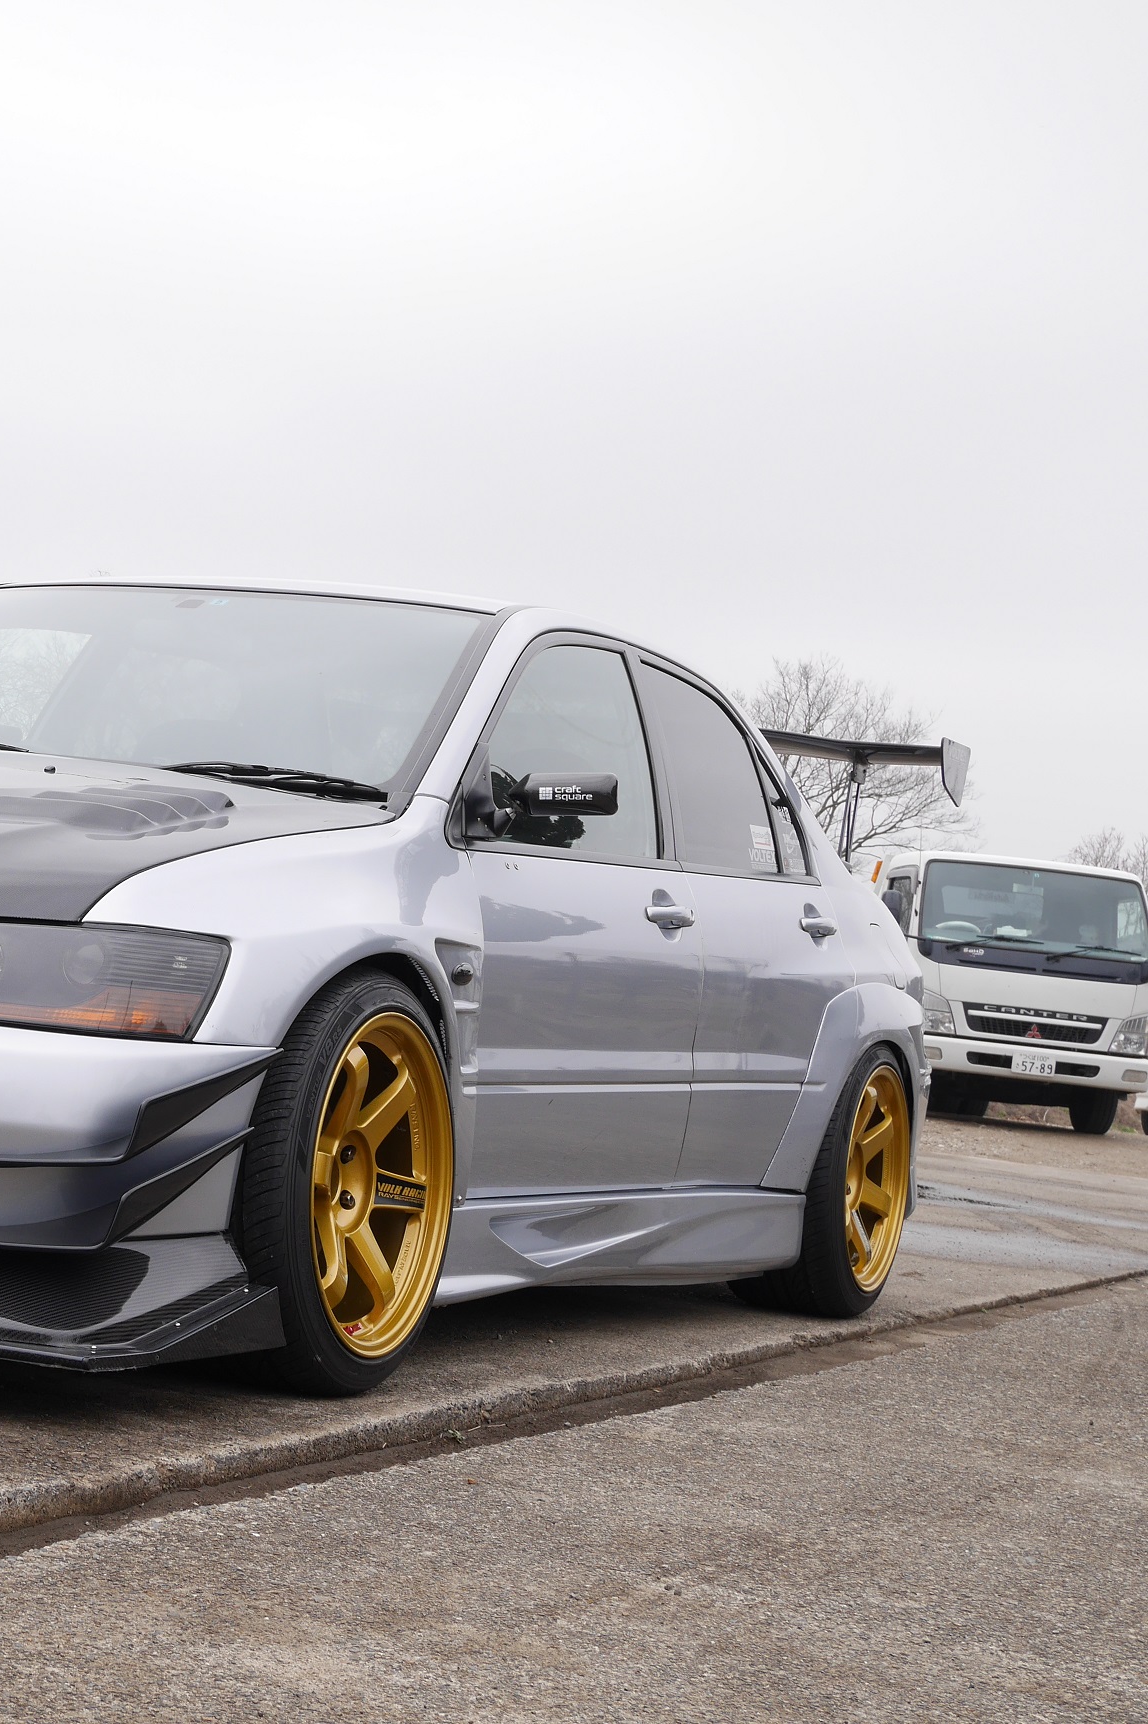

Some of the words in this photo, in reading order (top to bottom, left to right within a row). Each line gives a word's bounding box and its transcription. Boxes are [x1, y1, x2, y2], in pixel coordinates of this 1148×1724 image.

[554, 785, 581, 793] craft
[554, 793, 593, 801] square
[748, 848, 776, 864] VOLTEX
[983, 1004, 1088, 1021] CANTER
[1021, 1060, 1053, 1074] 57-89
[377, 1181, 403, 1195] VOLK
